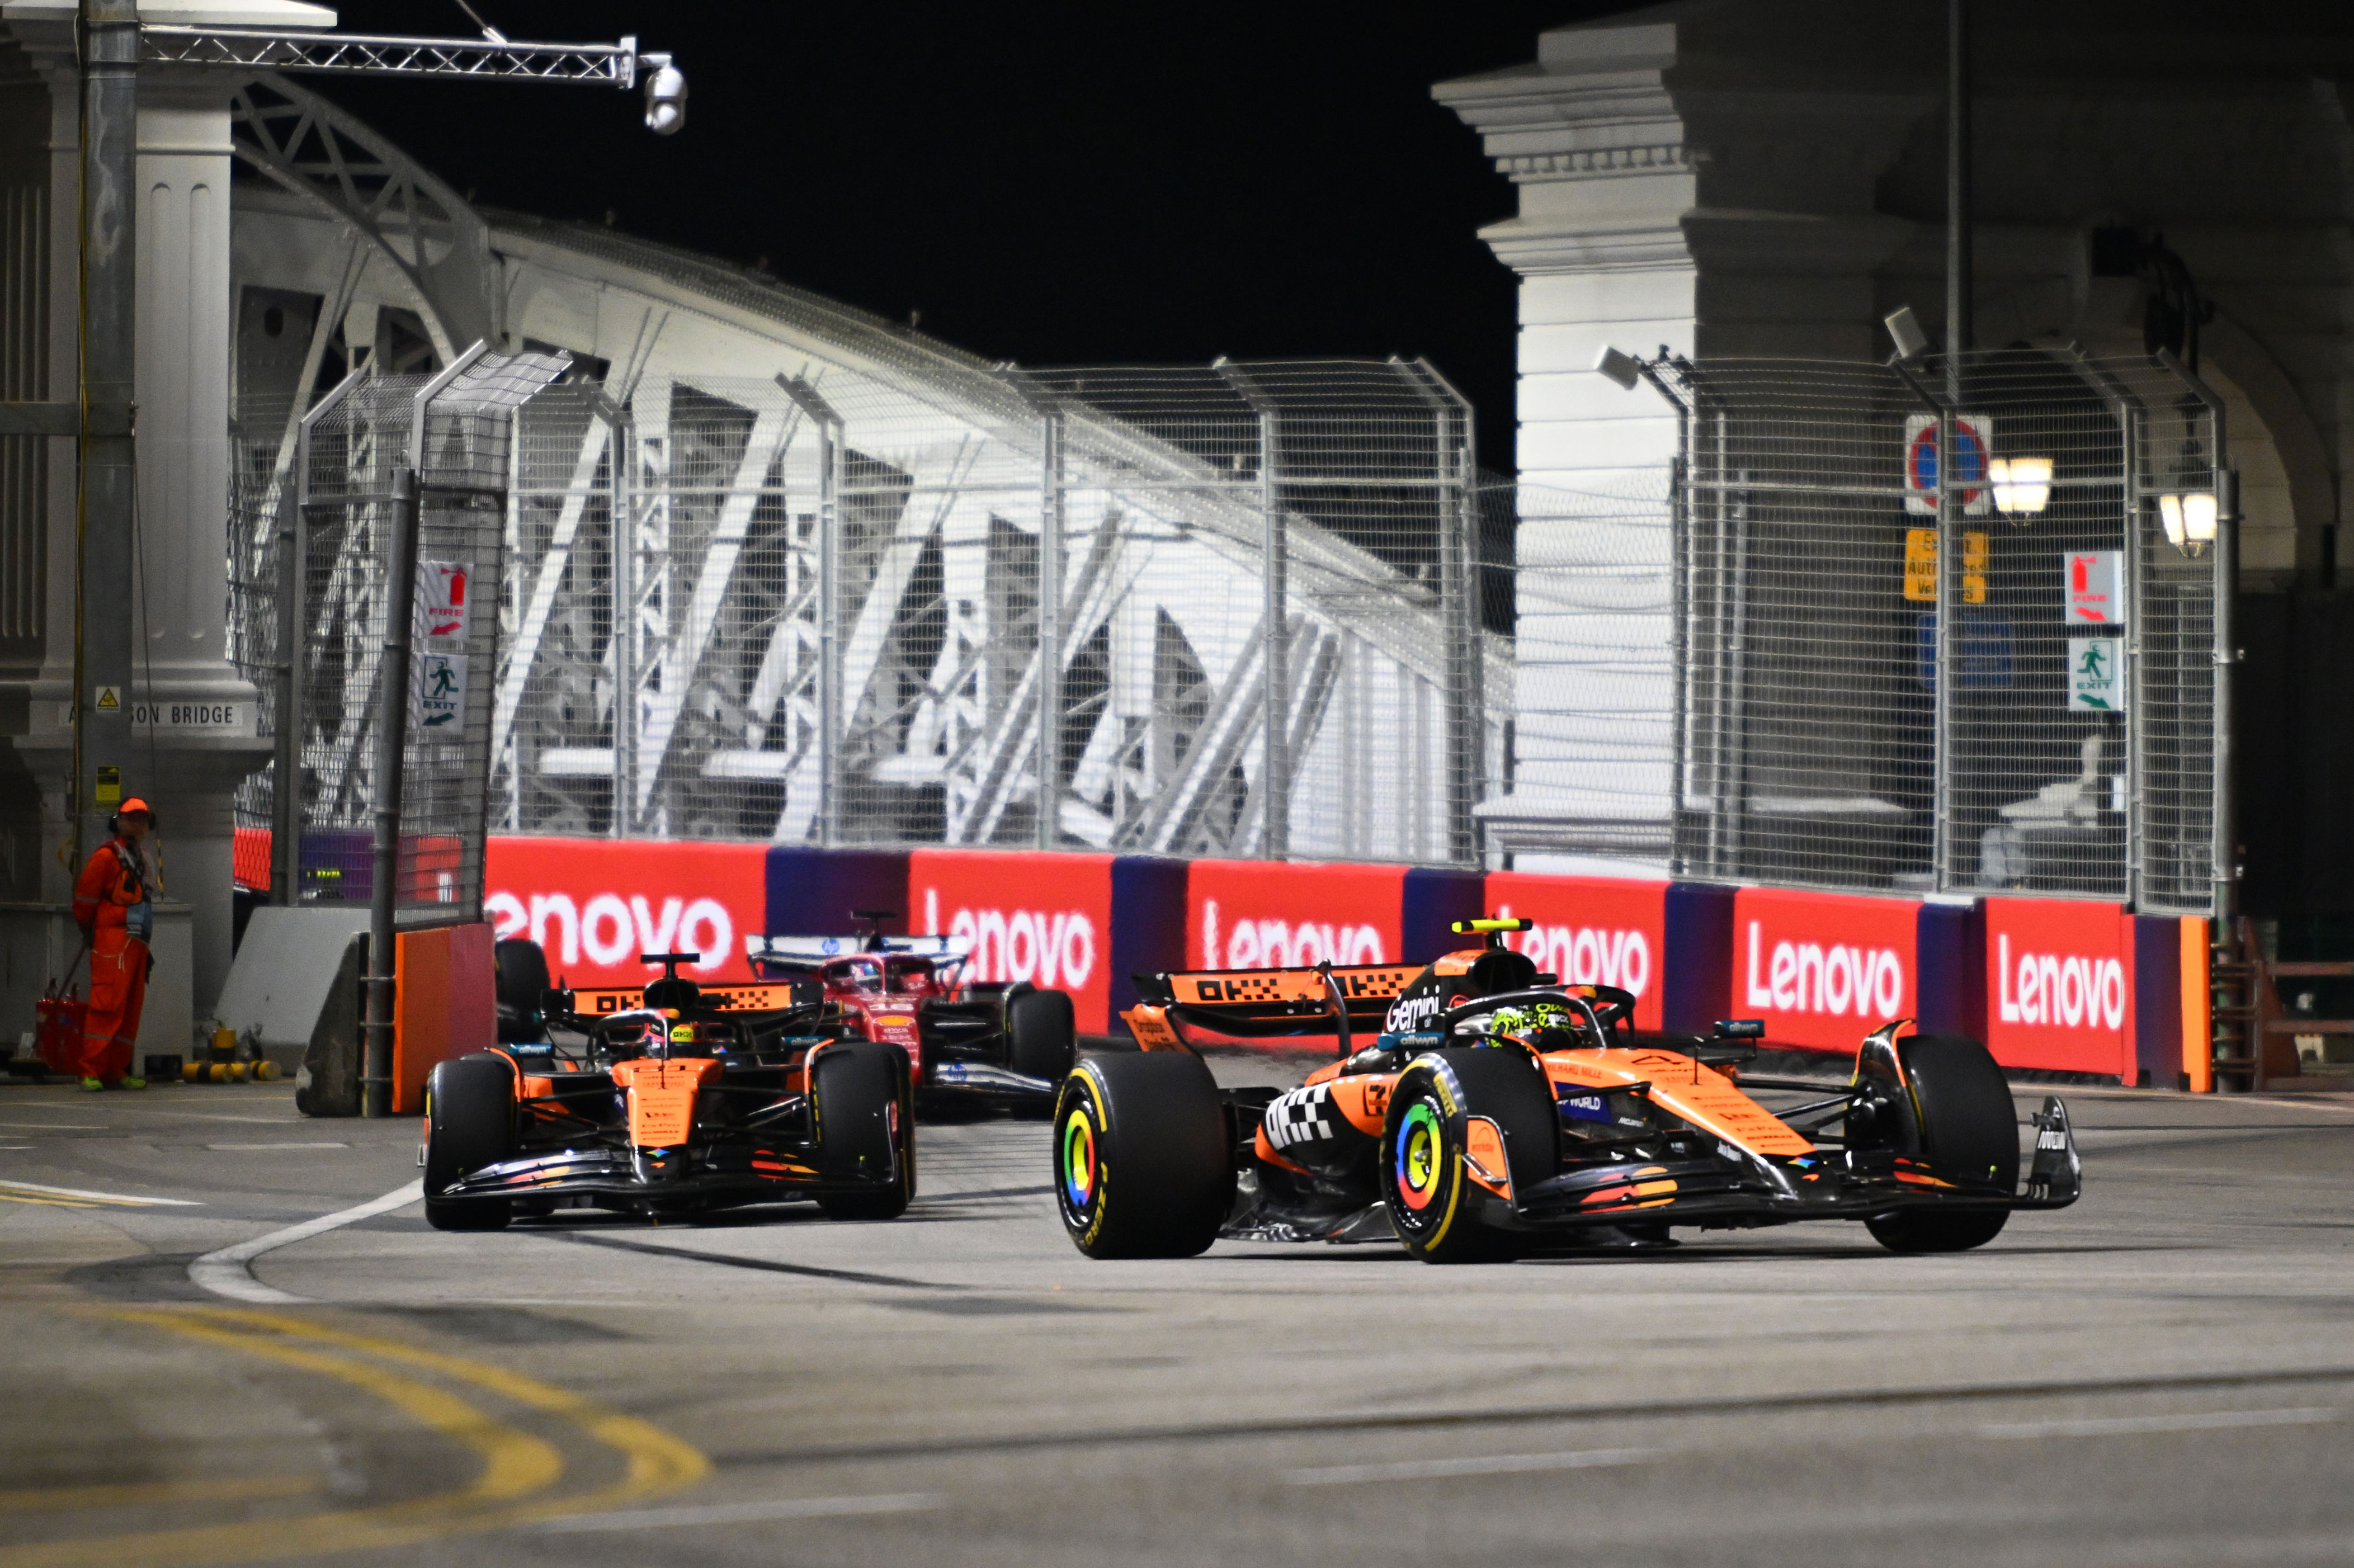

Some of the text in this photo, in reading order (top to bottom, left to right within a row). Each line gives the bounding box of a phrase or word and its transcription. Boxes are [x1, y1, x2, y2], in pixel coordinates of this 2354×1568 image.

[429, 607, 464, 617] FIRE
[423, 701, 457, 710] EXIT
[171, 706, 233, 724] BRIDGE
[484, 891, 733, 971] enovo
[1748, 921, 1901, 1018] Lenovo
[1999, 933, 2124, 1030] Lenovo
[597, 995, 641, 1012] OK
[1386, 985, 1440, 1032] Gemini
[1400, 1035, 1438, 1046] allwyn
[1570, 1097, 1601, 1111] WORLD
